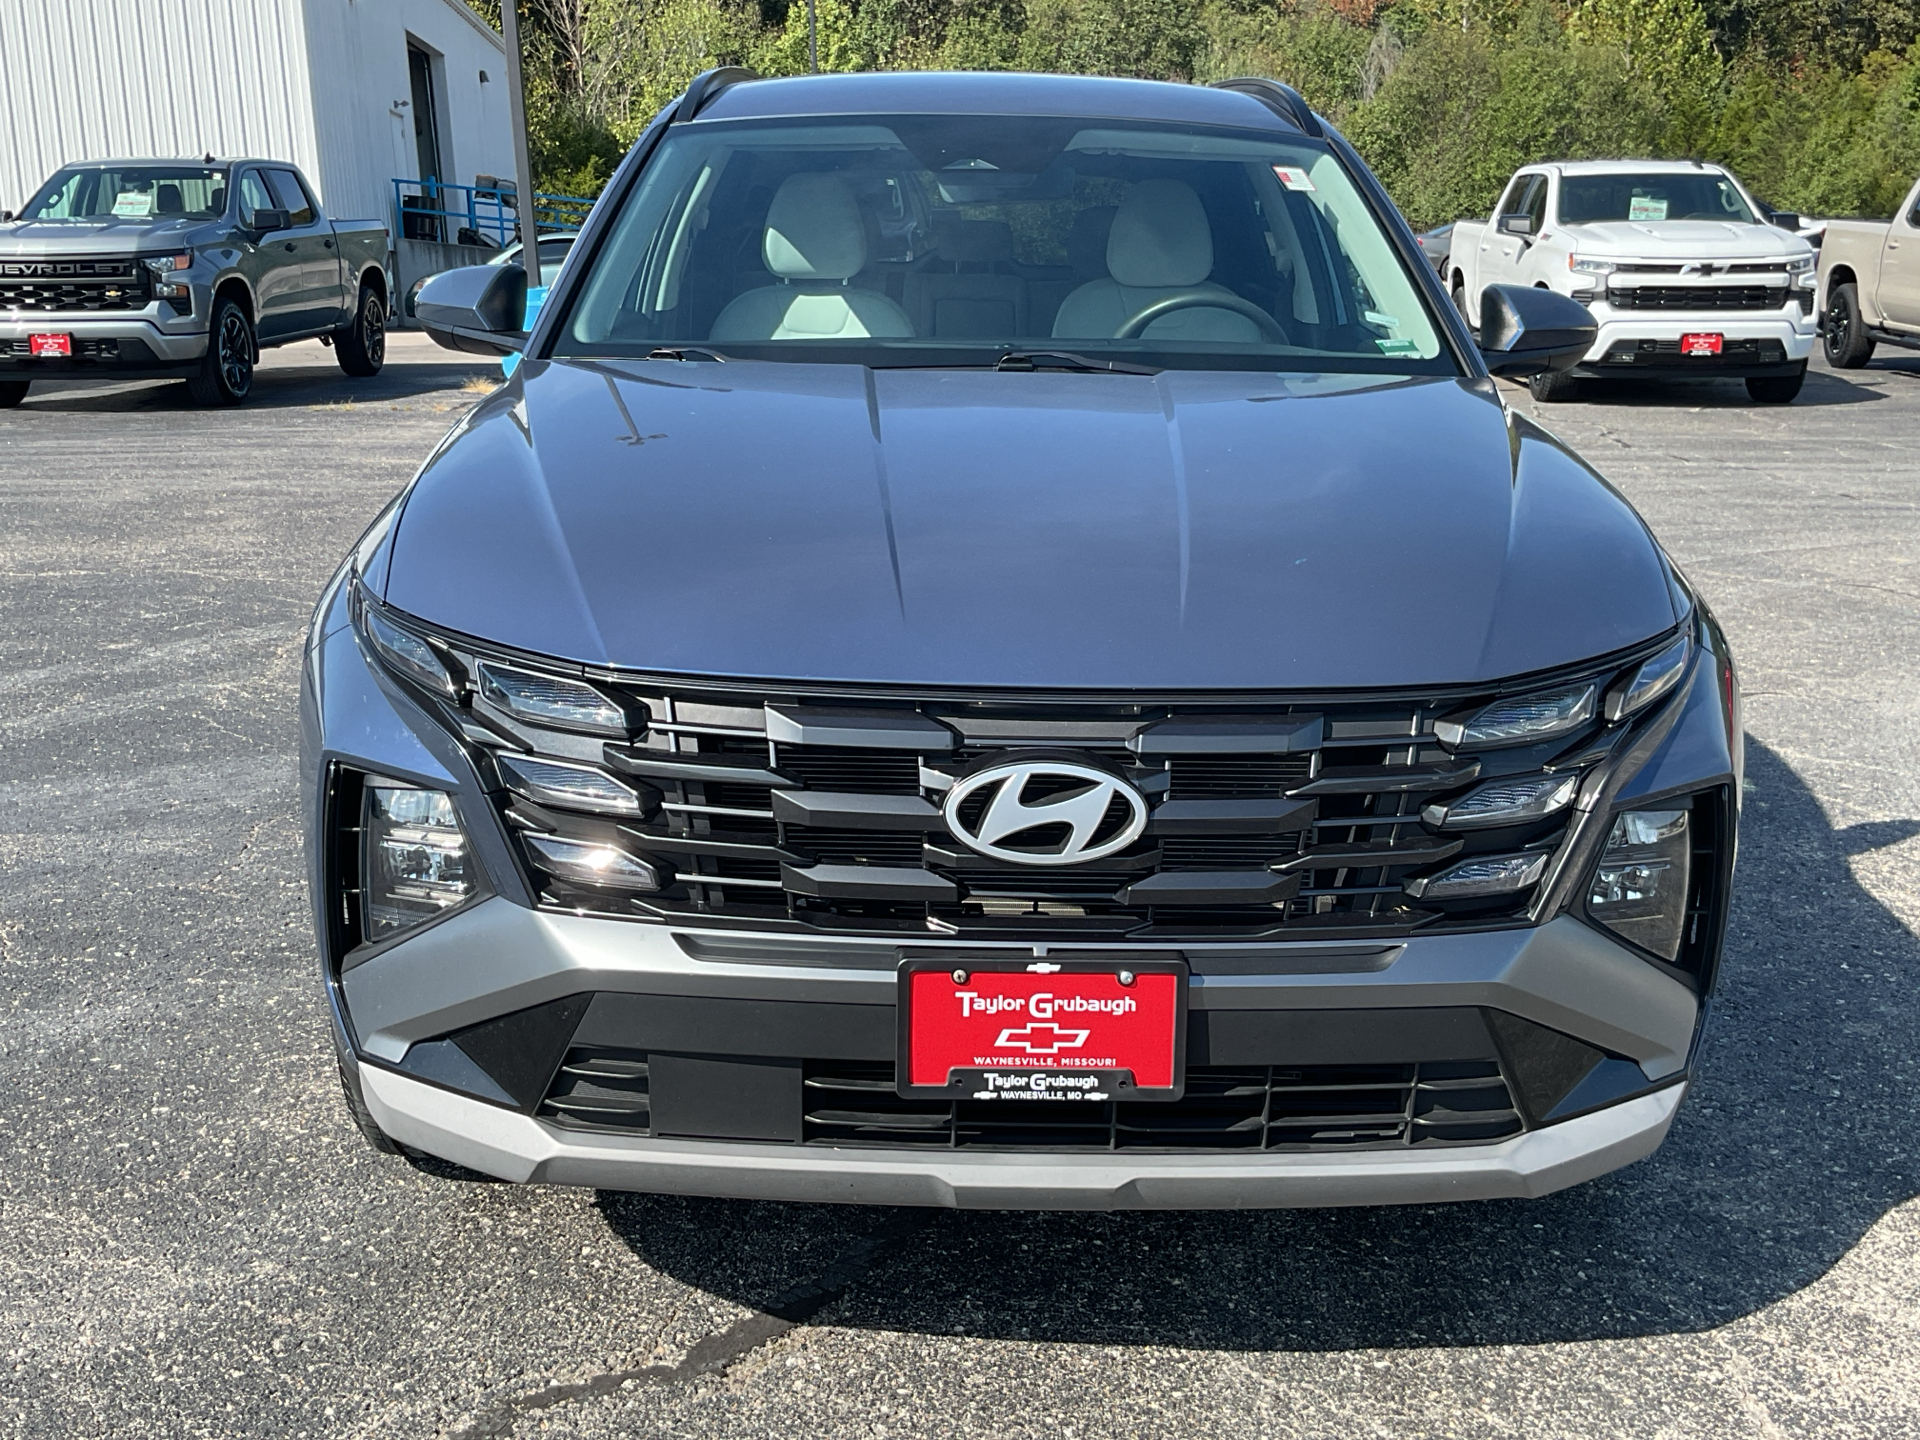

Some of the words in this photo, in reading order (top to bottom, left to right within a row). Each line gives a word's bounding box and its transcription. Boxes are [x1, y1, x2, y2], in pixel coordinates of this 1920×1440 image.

[0, 263, 130, 274] EVROLET
[954, 991, 1026, 1018] Taylor
[1028, 992, 1137, 1019] Grubaugh
[973, 1056, 1058, 1067] WAYNESVILLE,
[1060, 1057, 1117, 1067] MISSOURI
[983, 1072, 1029, 1090] Taylor
[1029, 1073, 1099, 1090] Grubaugh
[1000, 1090, 1066, 1101] WAYNESVILLE,
[1067, 1091, 1082, 1100] MO
